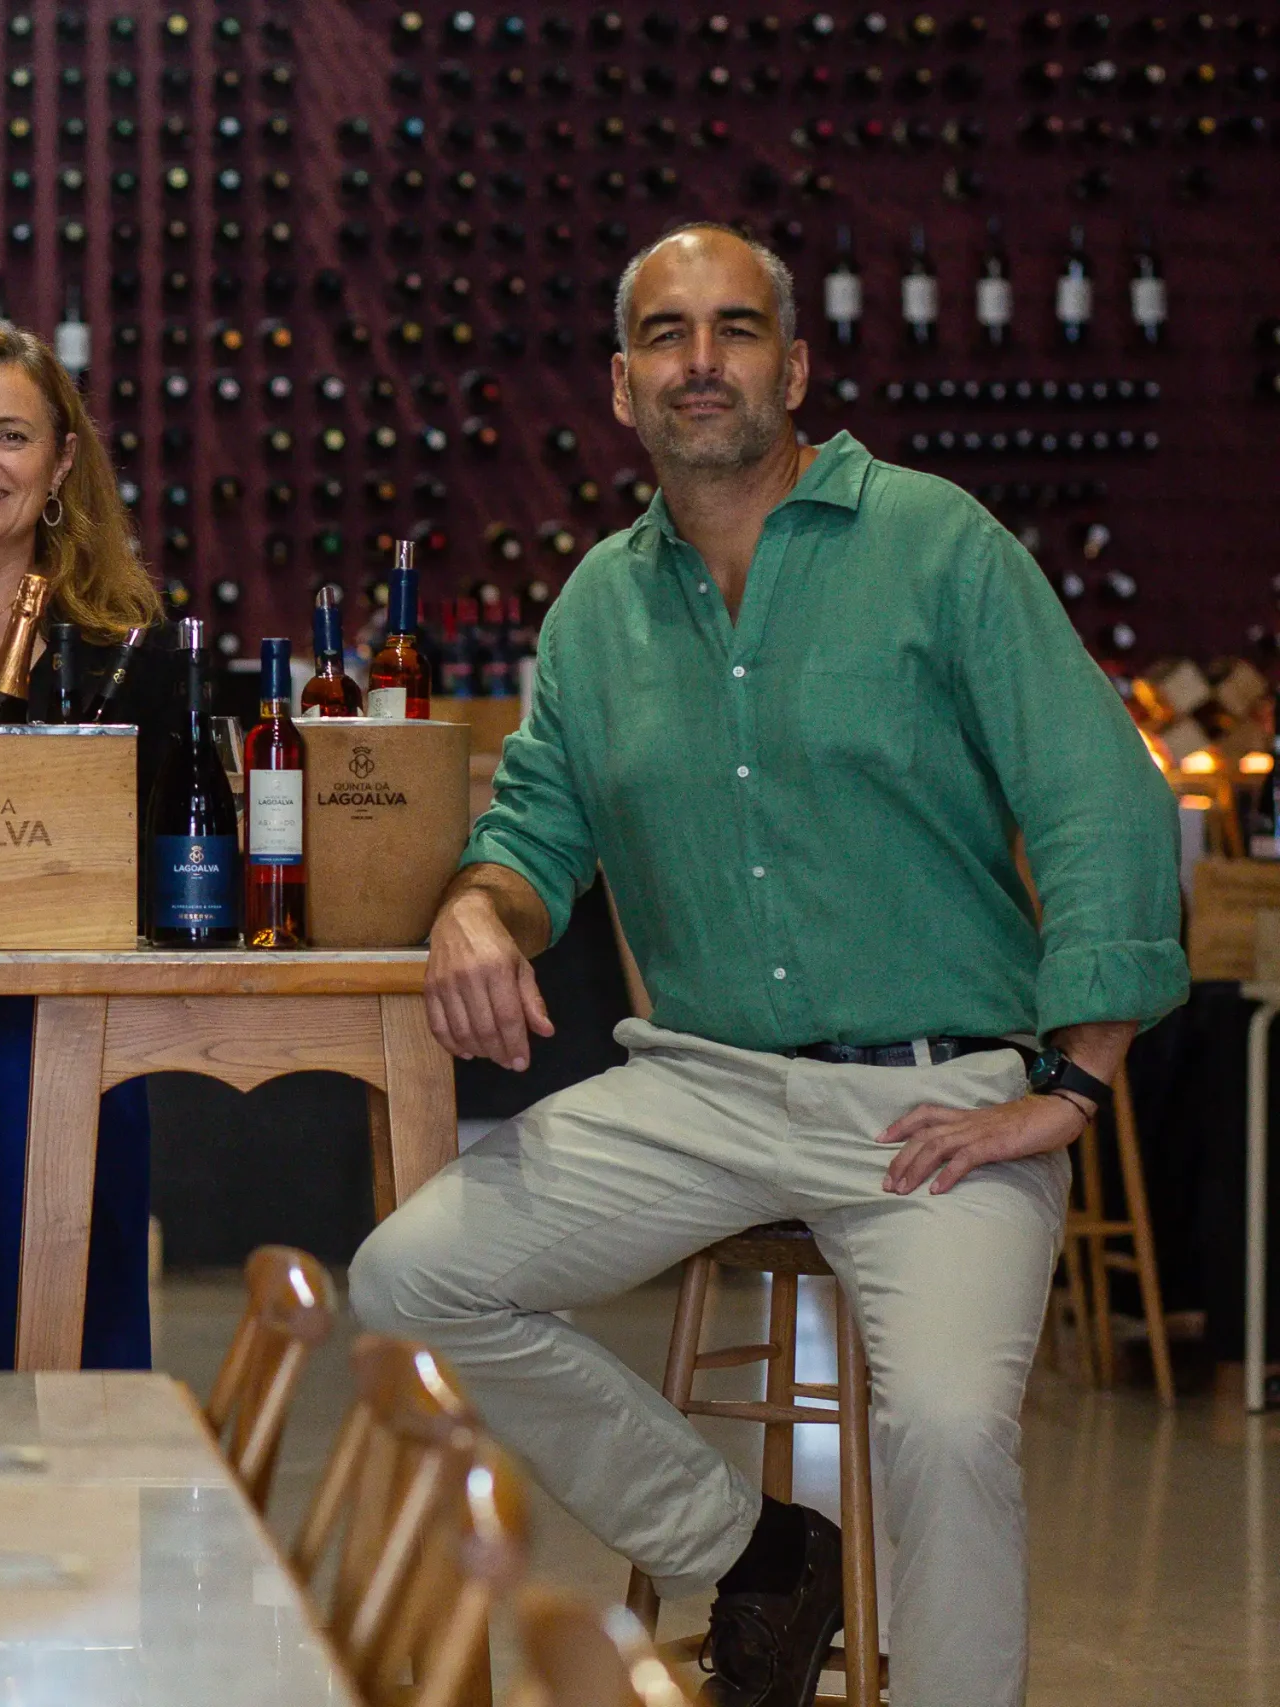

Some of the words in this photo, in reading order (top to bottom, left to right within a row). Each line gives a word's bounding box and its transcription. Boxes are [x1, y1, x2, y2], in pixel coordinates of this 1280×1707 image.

[333, 782, 372, 791] QUINTA
[375, 782, 391, 791] DA
[317, 792, 407, 806] LAGOALVA
[173, 864, 220, 873] LAGOALVA
